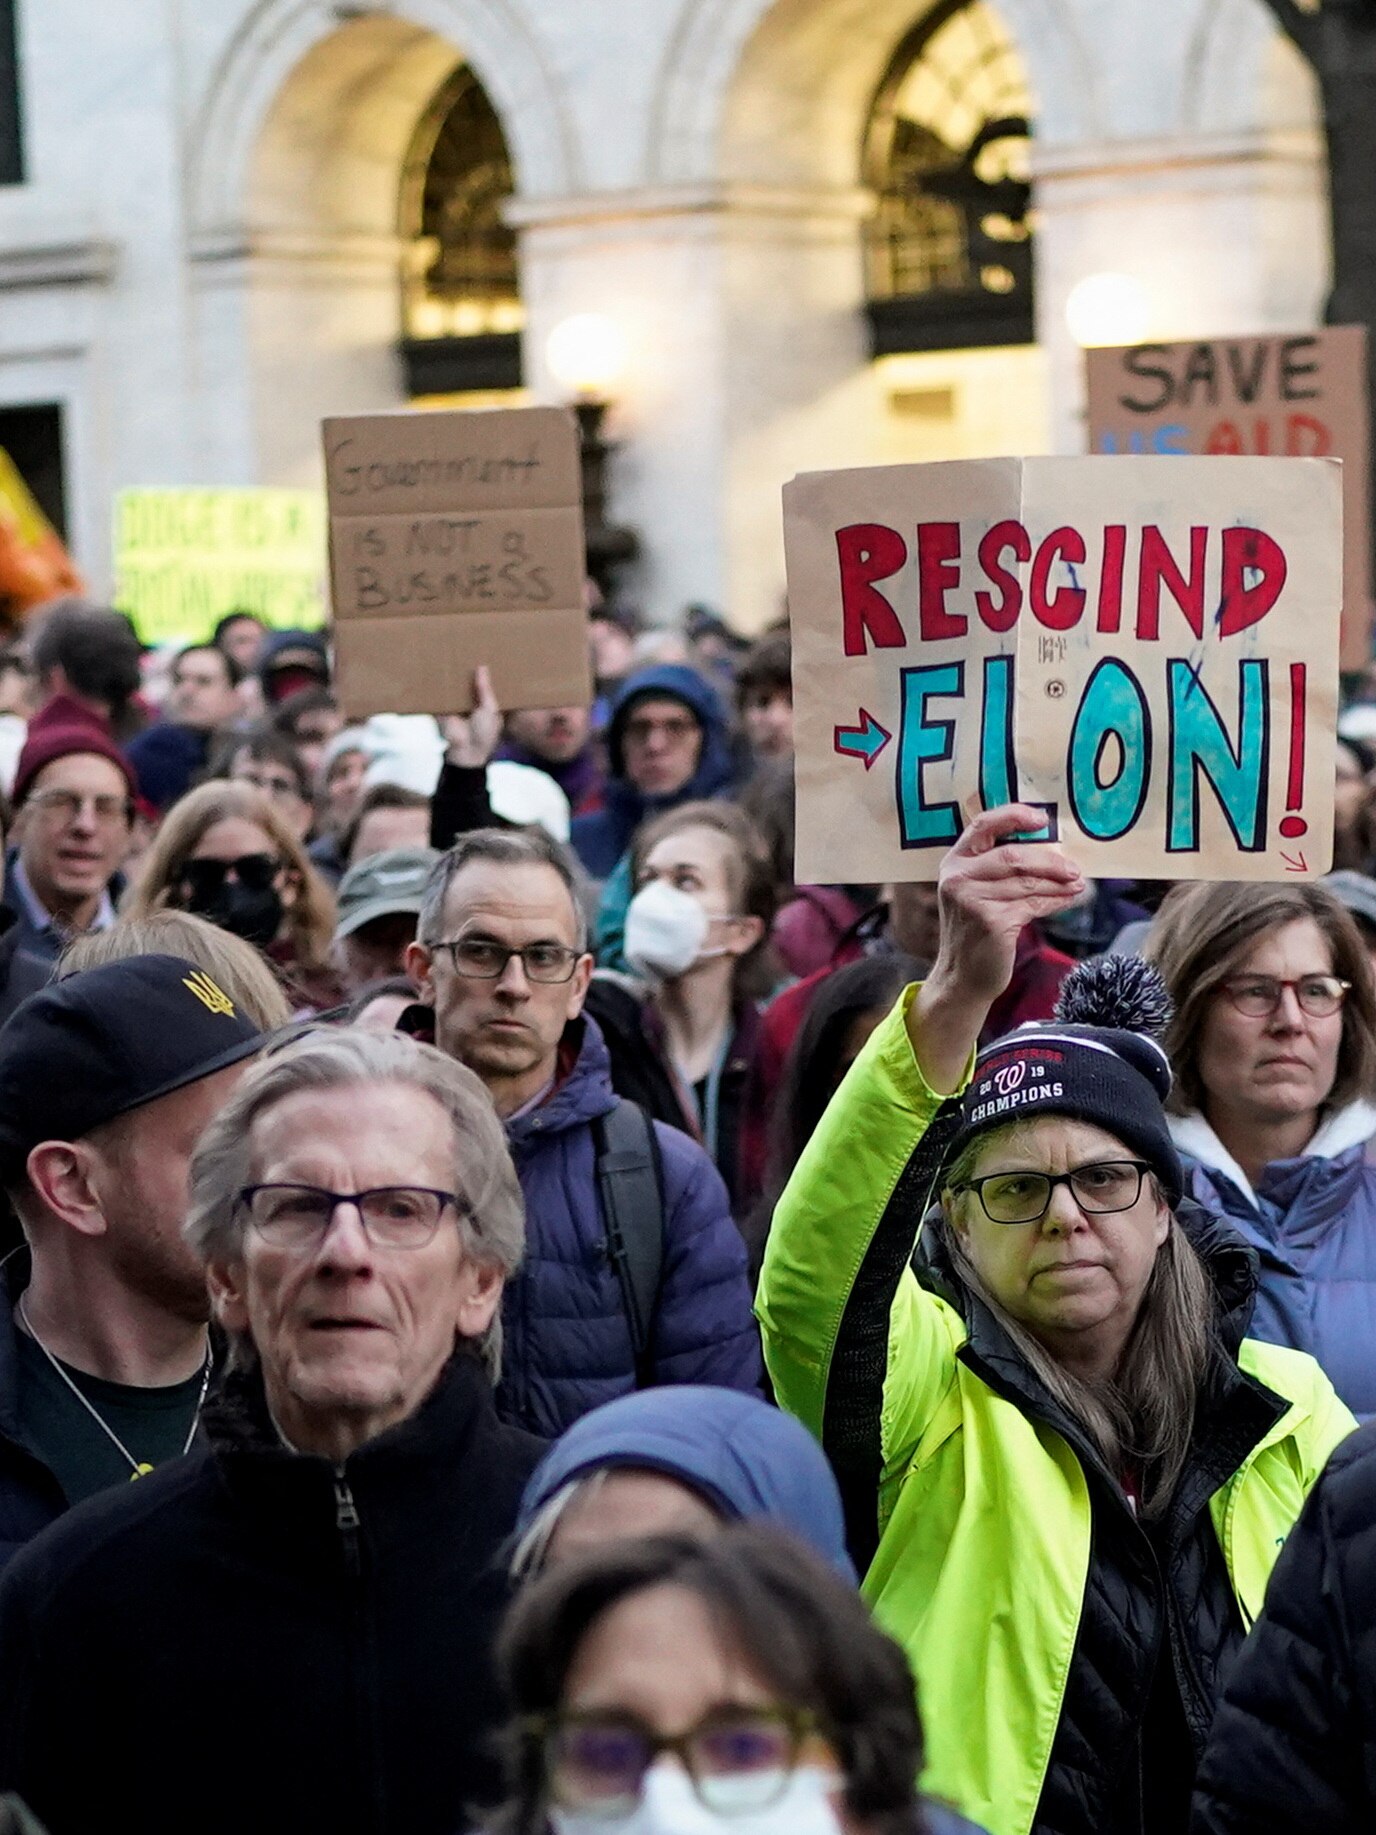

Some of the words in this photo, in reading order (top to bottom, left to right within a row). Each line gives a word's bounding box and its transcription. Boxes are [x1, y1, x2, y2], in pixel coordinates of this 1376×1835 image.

[1118, 336, 1322, 416] SAVE
[404, 518, 482, 557] NOT
[834, 519, 1288, 657] RESCIND
[895, 654, 1309, 854] ELON!
[971, 1082, 1064, 1122] CHAMPIONS
[980, 1080, 992, 1096] 20
[1031, 1065, 1045, 1078] 19
